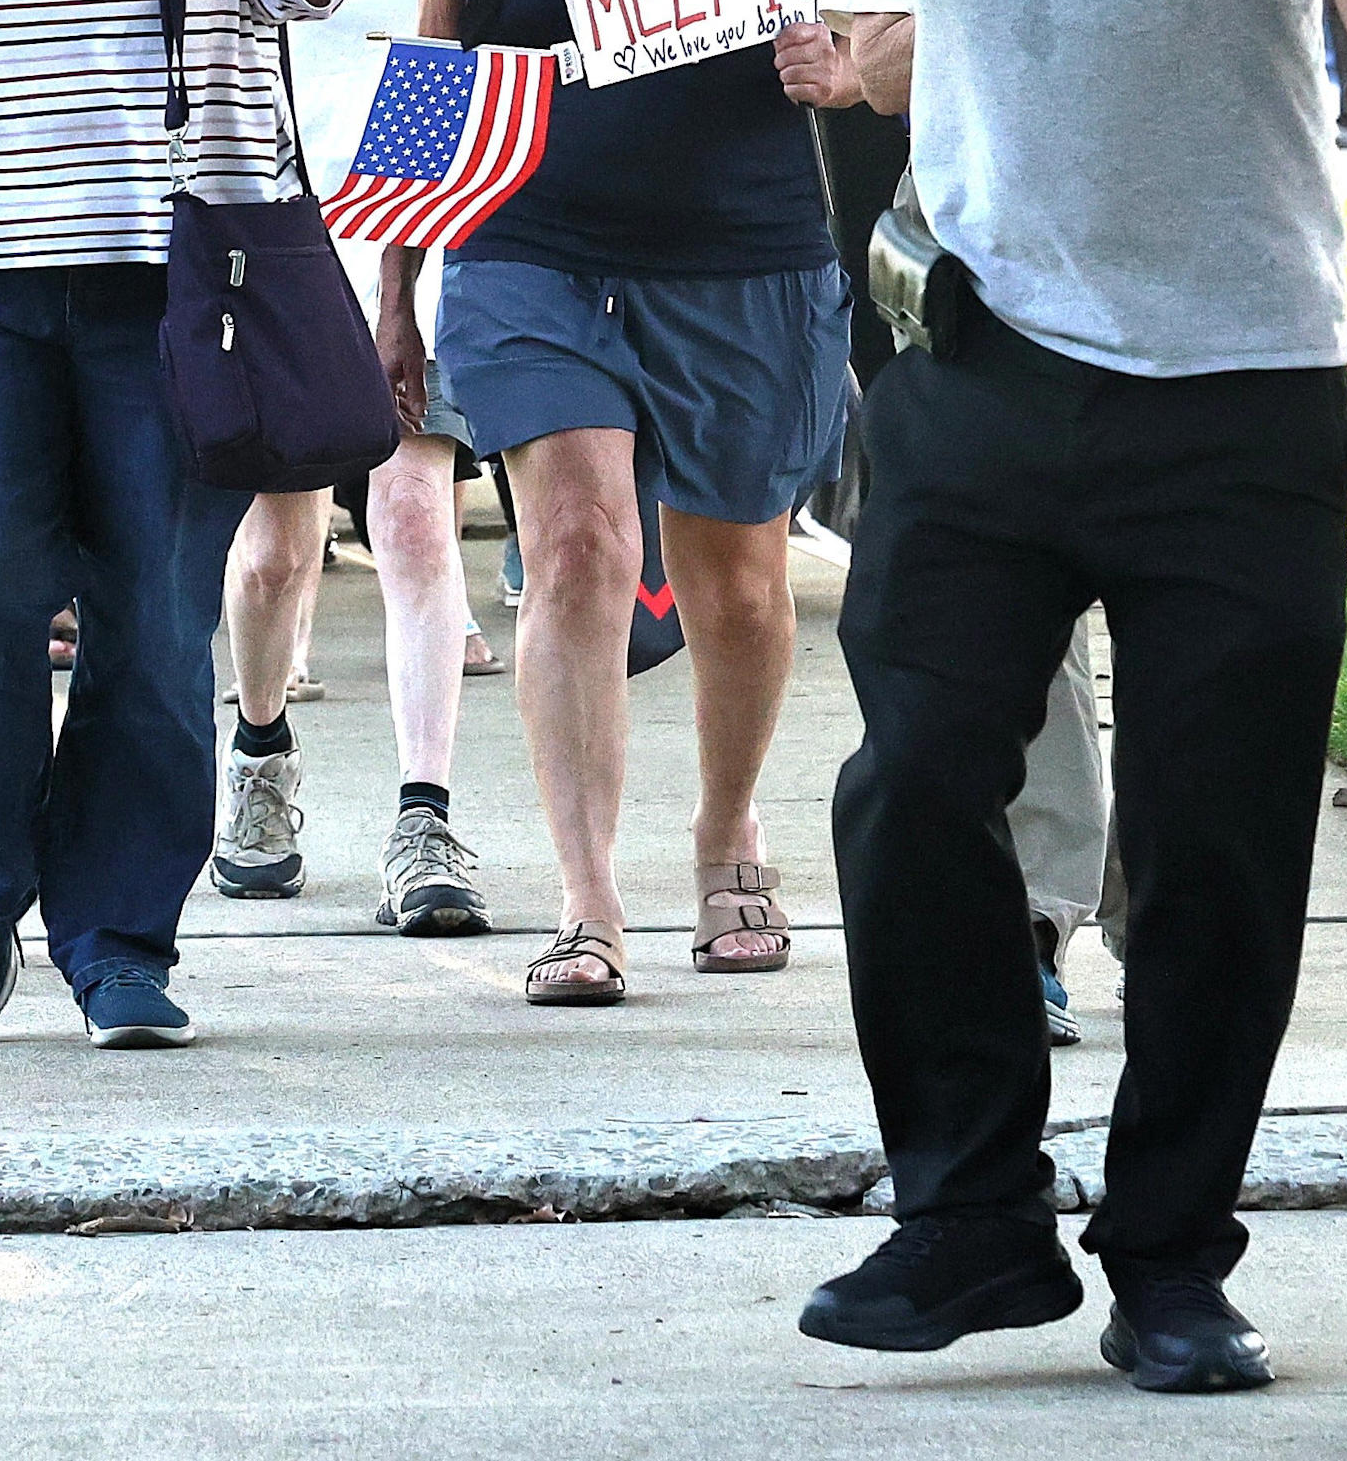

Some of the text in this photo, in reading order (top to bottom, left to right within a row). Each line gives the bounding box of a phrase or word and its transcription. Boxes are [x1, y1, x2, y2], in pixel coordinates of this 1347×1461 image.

[642, 37, 677, 67] We
[679, 34, 710, 57] love
[716, 20, 745, 49] you
